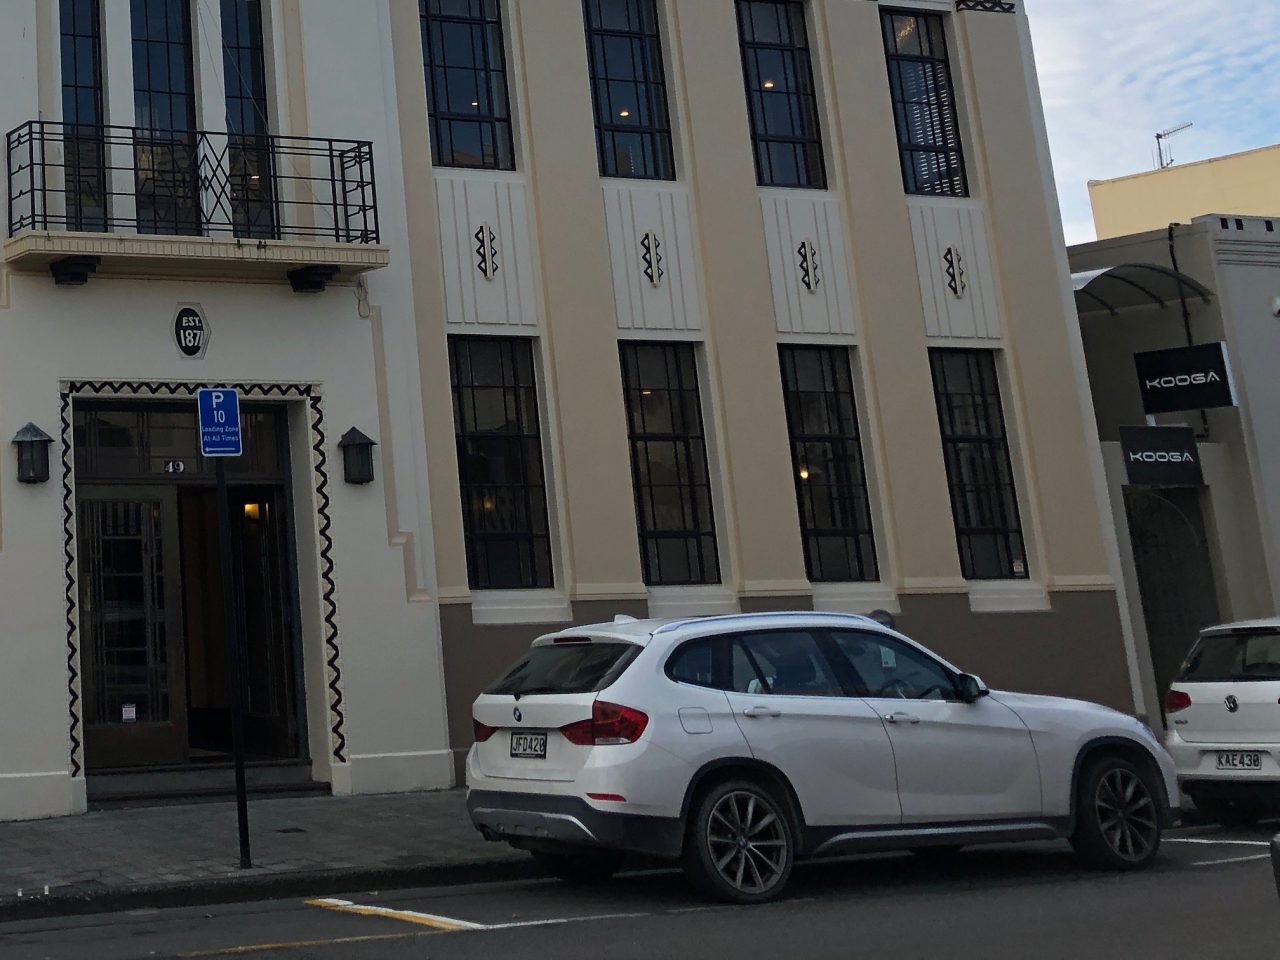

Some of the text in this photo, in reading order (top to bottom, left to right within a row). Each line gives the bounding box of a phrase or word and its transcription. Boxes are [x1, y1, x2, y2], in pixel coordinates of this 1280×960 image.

[182, 316, 201, 327] EST.
[1146, 371, 1220, 389] KOOGA
[212, 392, 224, 408] P
[214, 410, 225, 423] 10
[1129, 451, 1194, 463] KOOGA
[165, 460, 184, 473] 49
